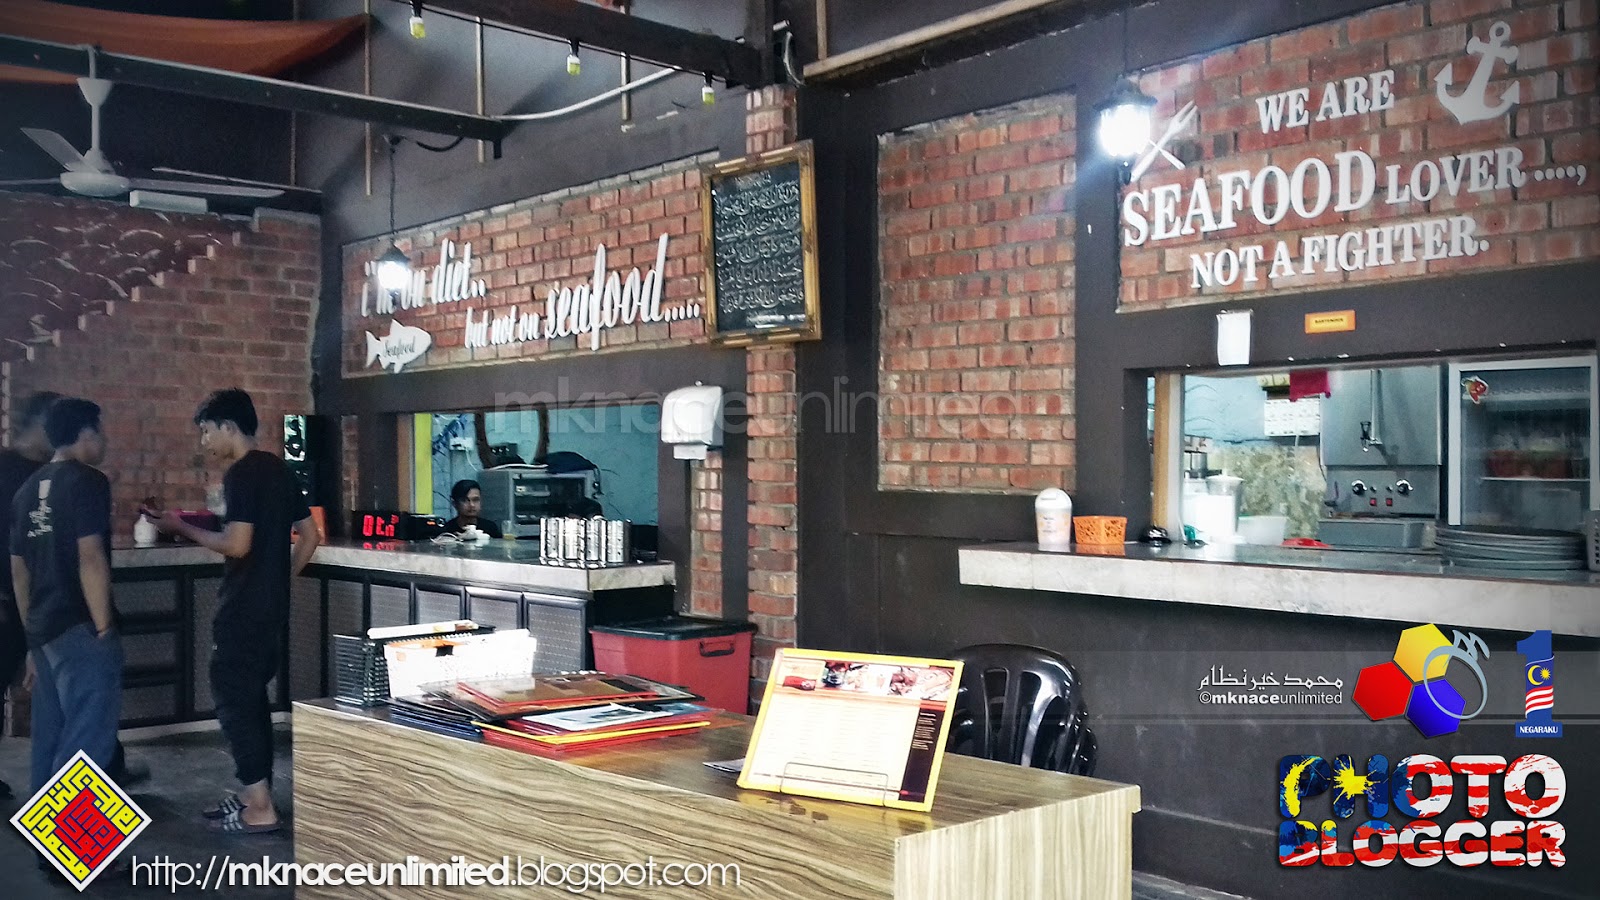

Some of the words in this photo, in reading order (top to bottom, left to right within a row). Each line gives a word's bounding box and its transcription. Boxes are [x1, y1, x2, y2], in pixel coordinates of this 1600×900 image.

[1256, 86, 1310, 134] WE
[1317, 69, 1395, 121] ARE
[1123, 149, 1376, 247] SEAFOOD
[1190, 245, 1263, 288] NOT
[1268, 240, 1296, 280] A
[1301, 216, 1490, 275] FIGHTER.
[465, 305, 489, 349] but
[490, 304, 517, 346] not
[518, 311, 540, 343] on
